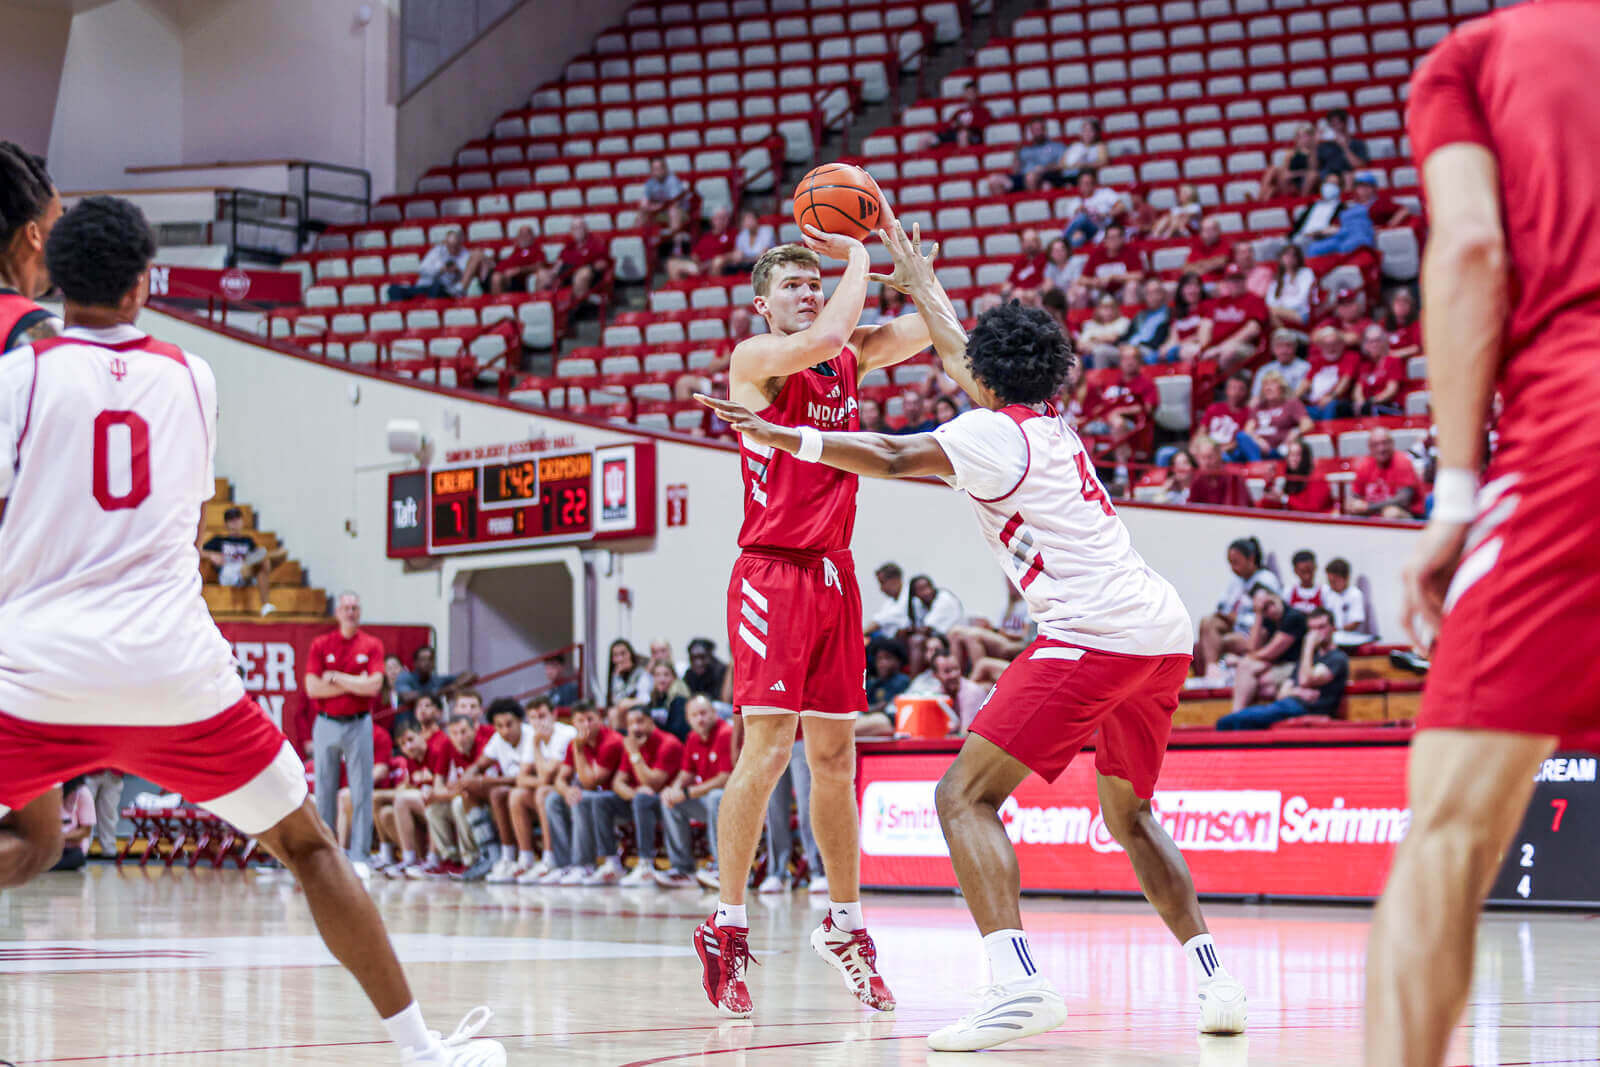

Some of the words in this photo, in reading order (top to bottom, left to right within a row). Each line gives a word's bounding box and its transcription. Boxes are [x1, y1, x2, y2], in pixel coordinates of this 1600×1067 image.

[93, 409, 152, 512] 0
[540, 454, 591, 482] CRIMSON
[1073, 450, 1117, 517] 4
[393, 497, 417, 529] Taft
[562, 488, 587, 525] 22
[1151, 799, 1272, 843] rimson
[1551, 799, 1568, 832] 7
[1520, 843, 1534, 867] 2
[1517, 875, 1531, 898] 4
